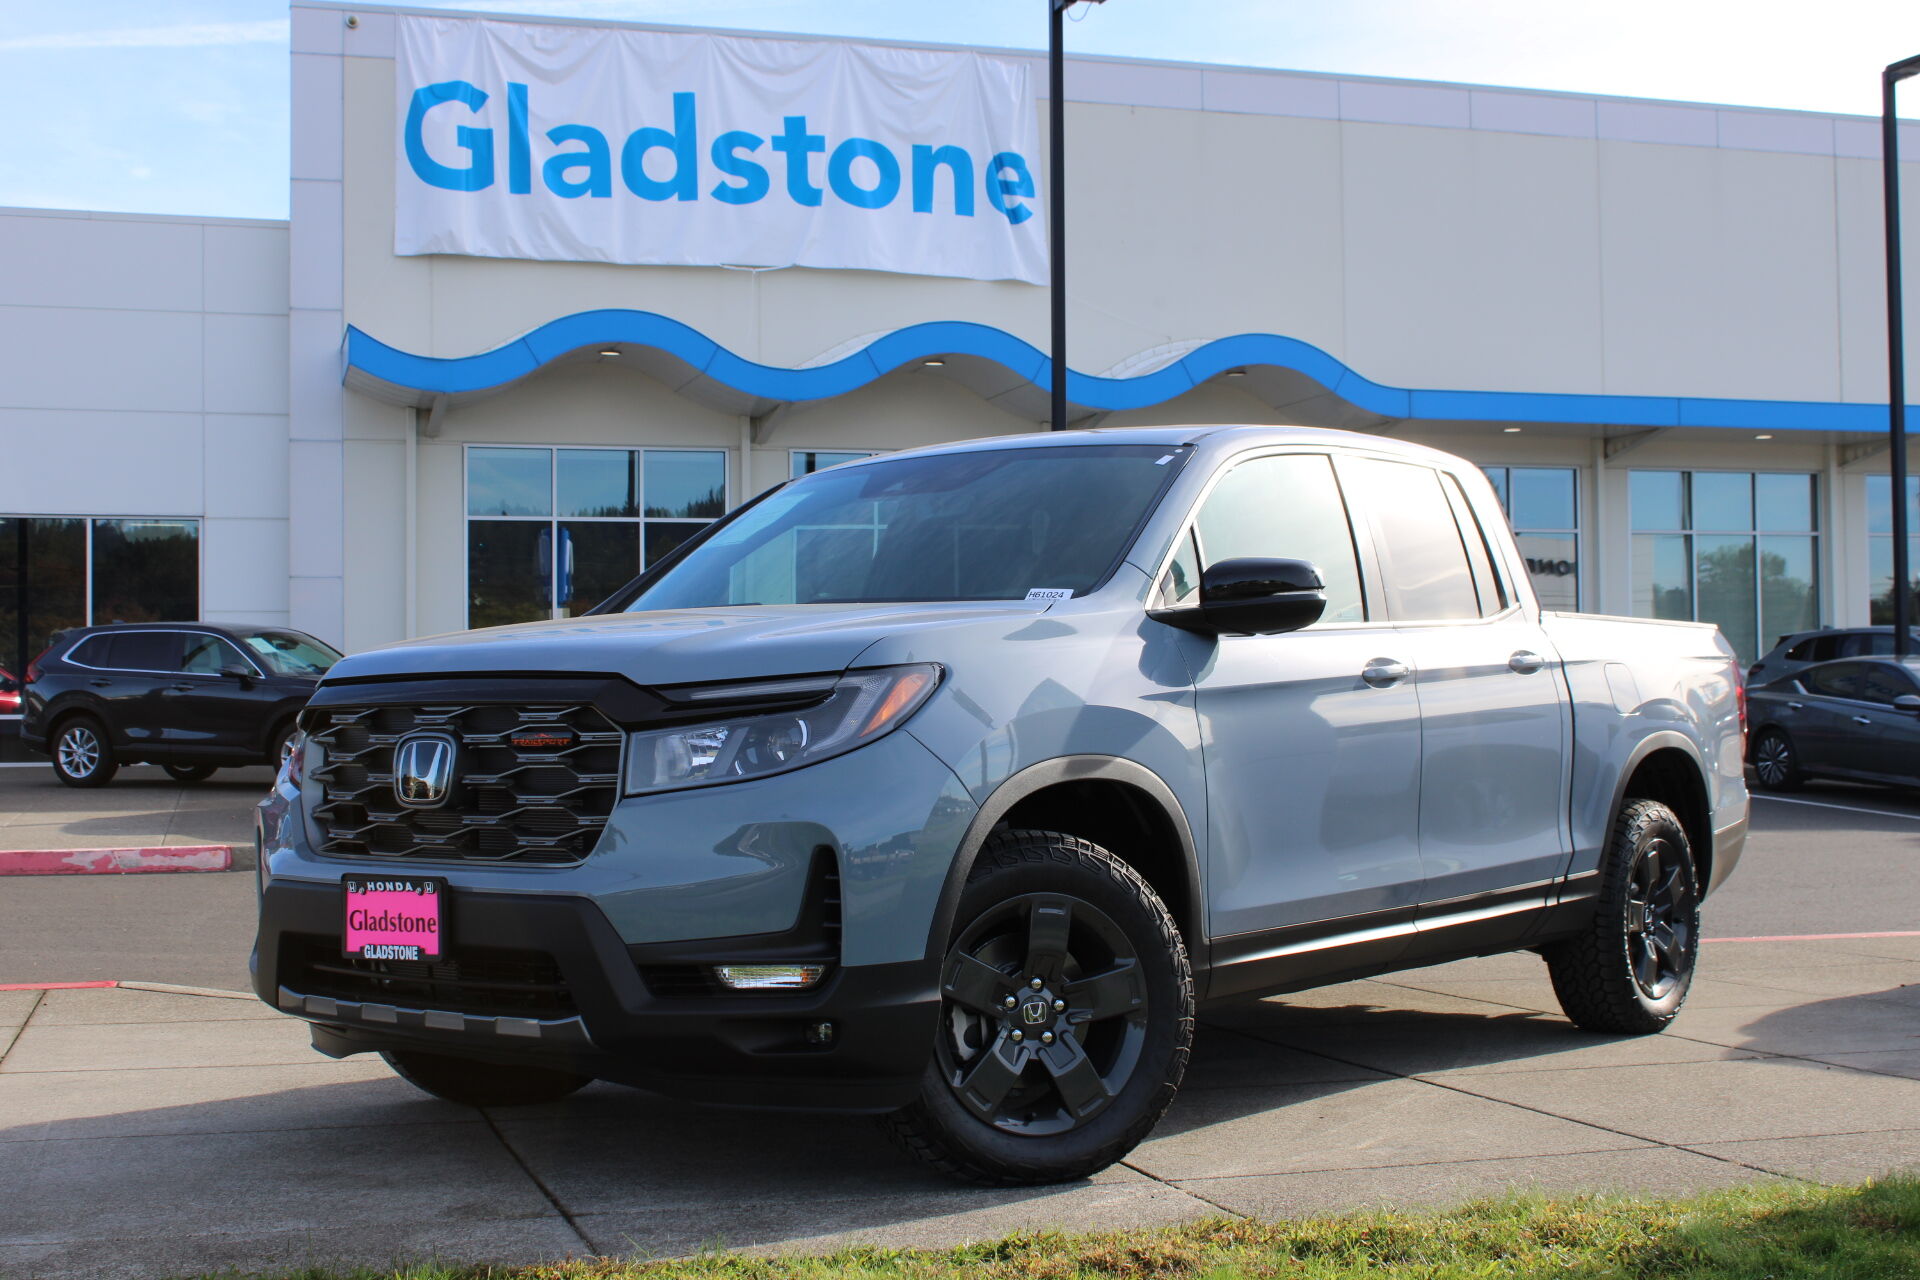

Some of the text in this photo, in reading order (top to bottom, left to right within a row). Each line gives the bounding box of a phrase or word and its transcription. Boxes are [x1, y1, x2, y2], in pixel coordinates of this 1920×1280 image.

[404, 80, 1036, 226] Gladstone
[1028, 591, 1064, 599] H61024
[367, 881, 414, 892] HONDA
[349, 908, 437, 934] Gladstone
[364, 944, 419, 961] GLADSTONE
